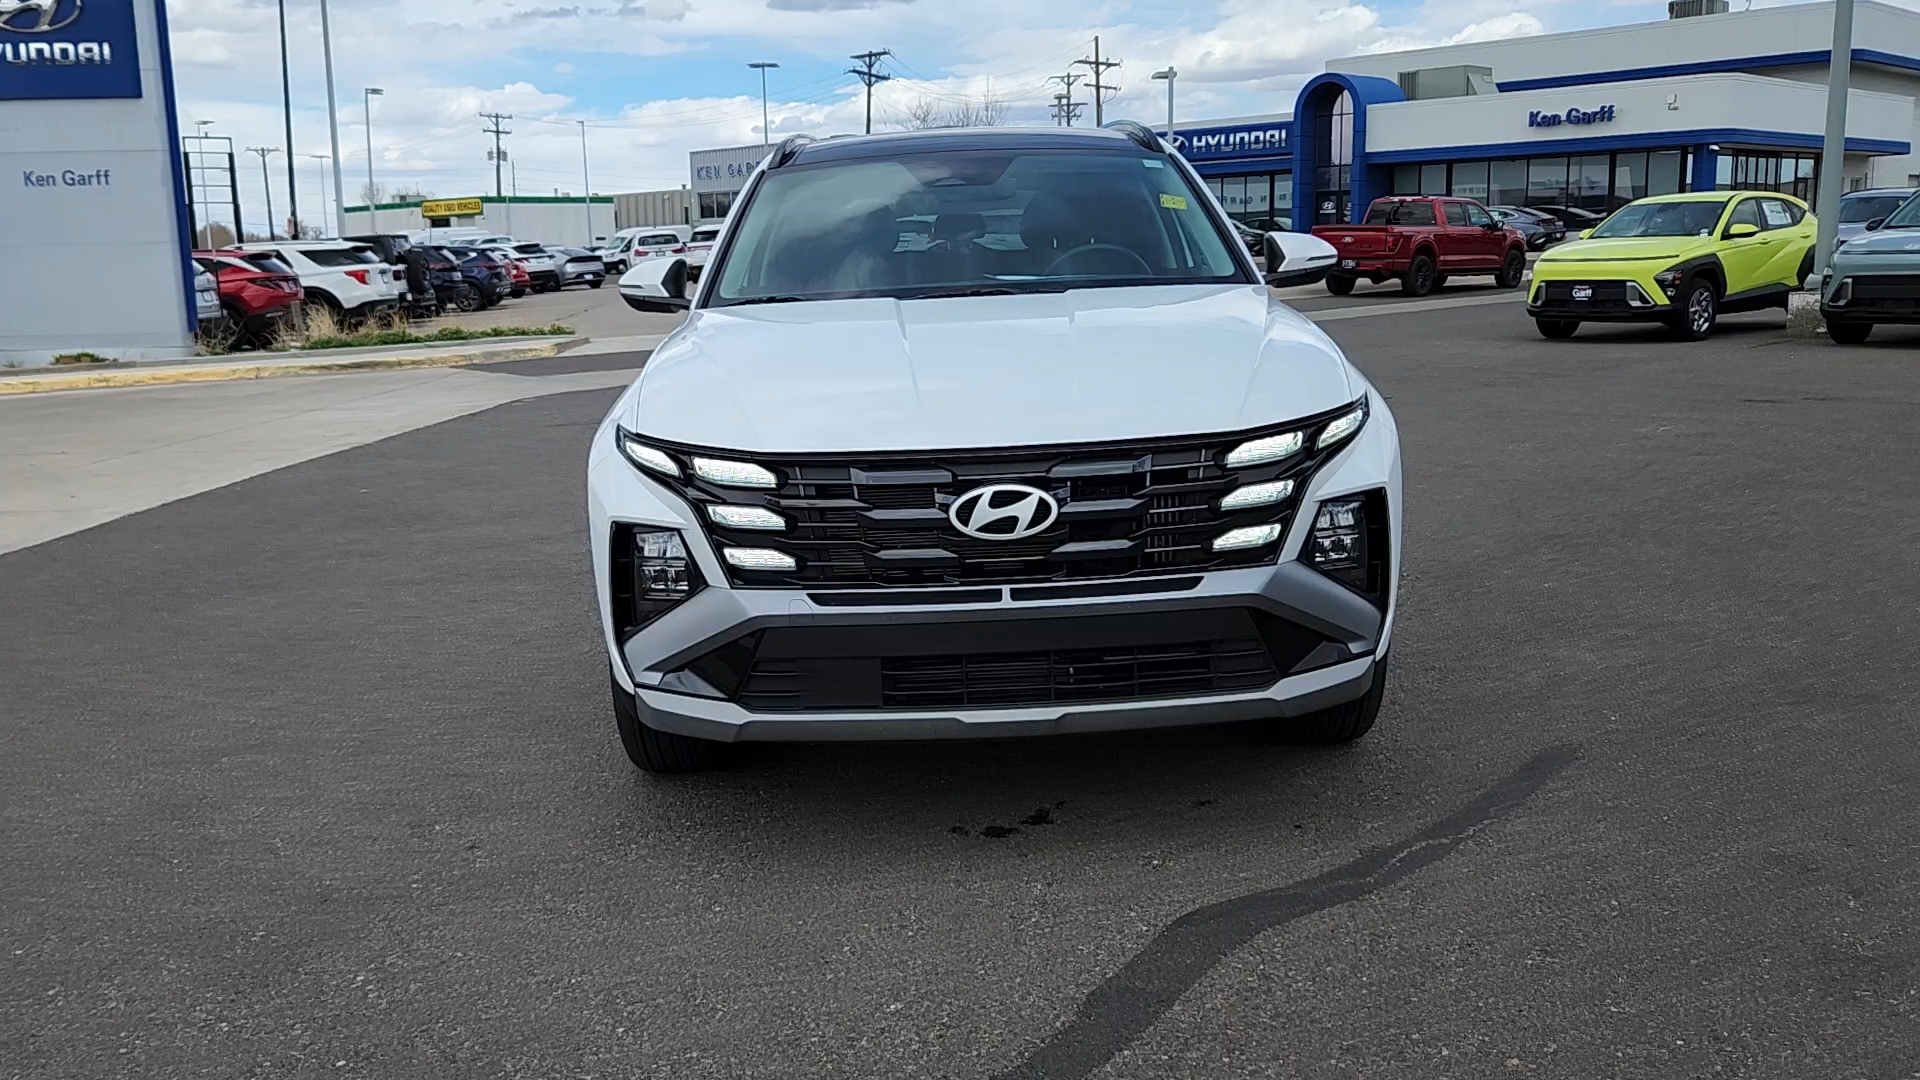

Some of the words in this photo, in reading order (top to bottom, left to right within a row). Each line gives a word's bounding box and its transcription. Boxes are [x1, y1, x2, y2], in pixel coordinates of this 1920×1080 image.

[0, 42, 111, 65] UNDAI
[1528, 110, 1561, 127] Ken
[1566, 104, 1615, 124] Garff
[1192, 129, 1286, 153] HYUNDAI
[23, 170, 56, 187] Ken
[61, 169, 110, 186] Garff
[697, 165, 721, 180] KEN
[423, 203, 443, 213] QUALITY
[444, 203, 456, 212] USED
[457, 201, 480, 211] VEHICLES
